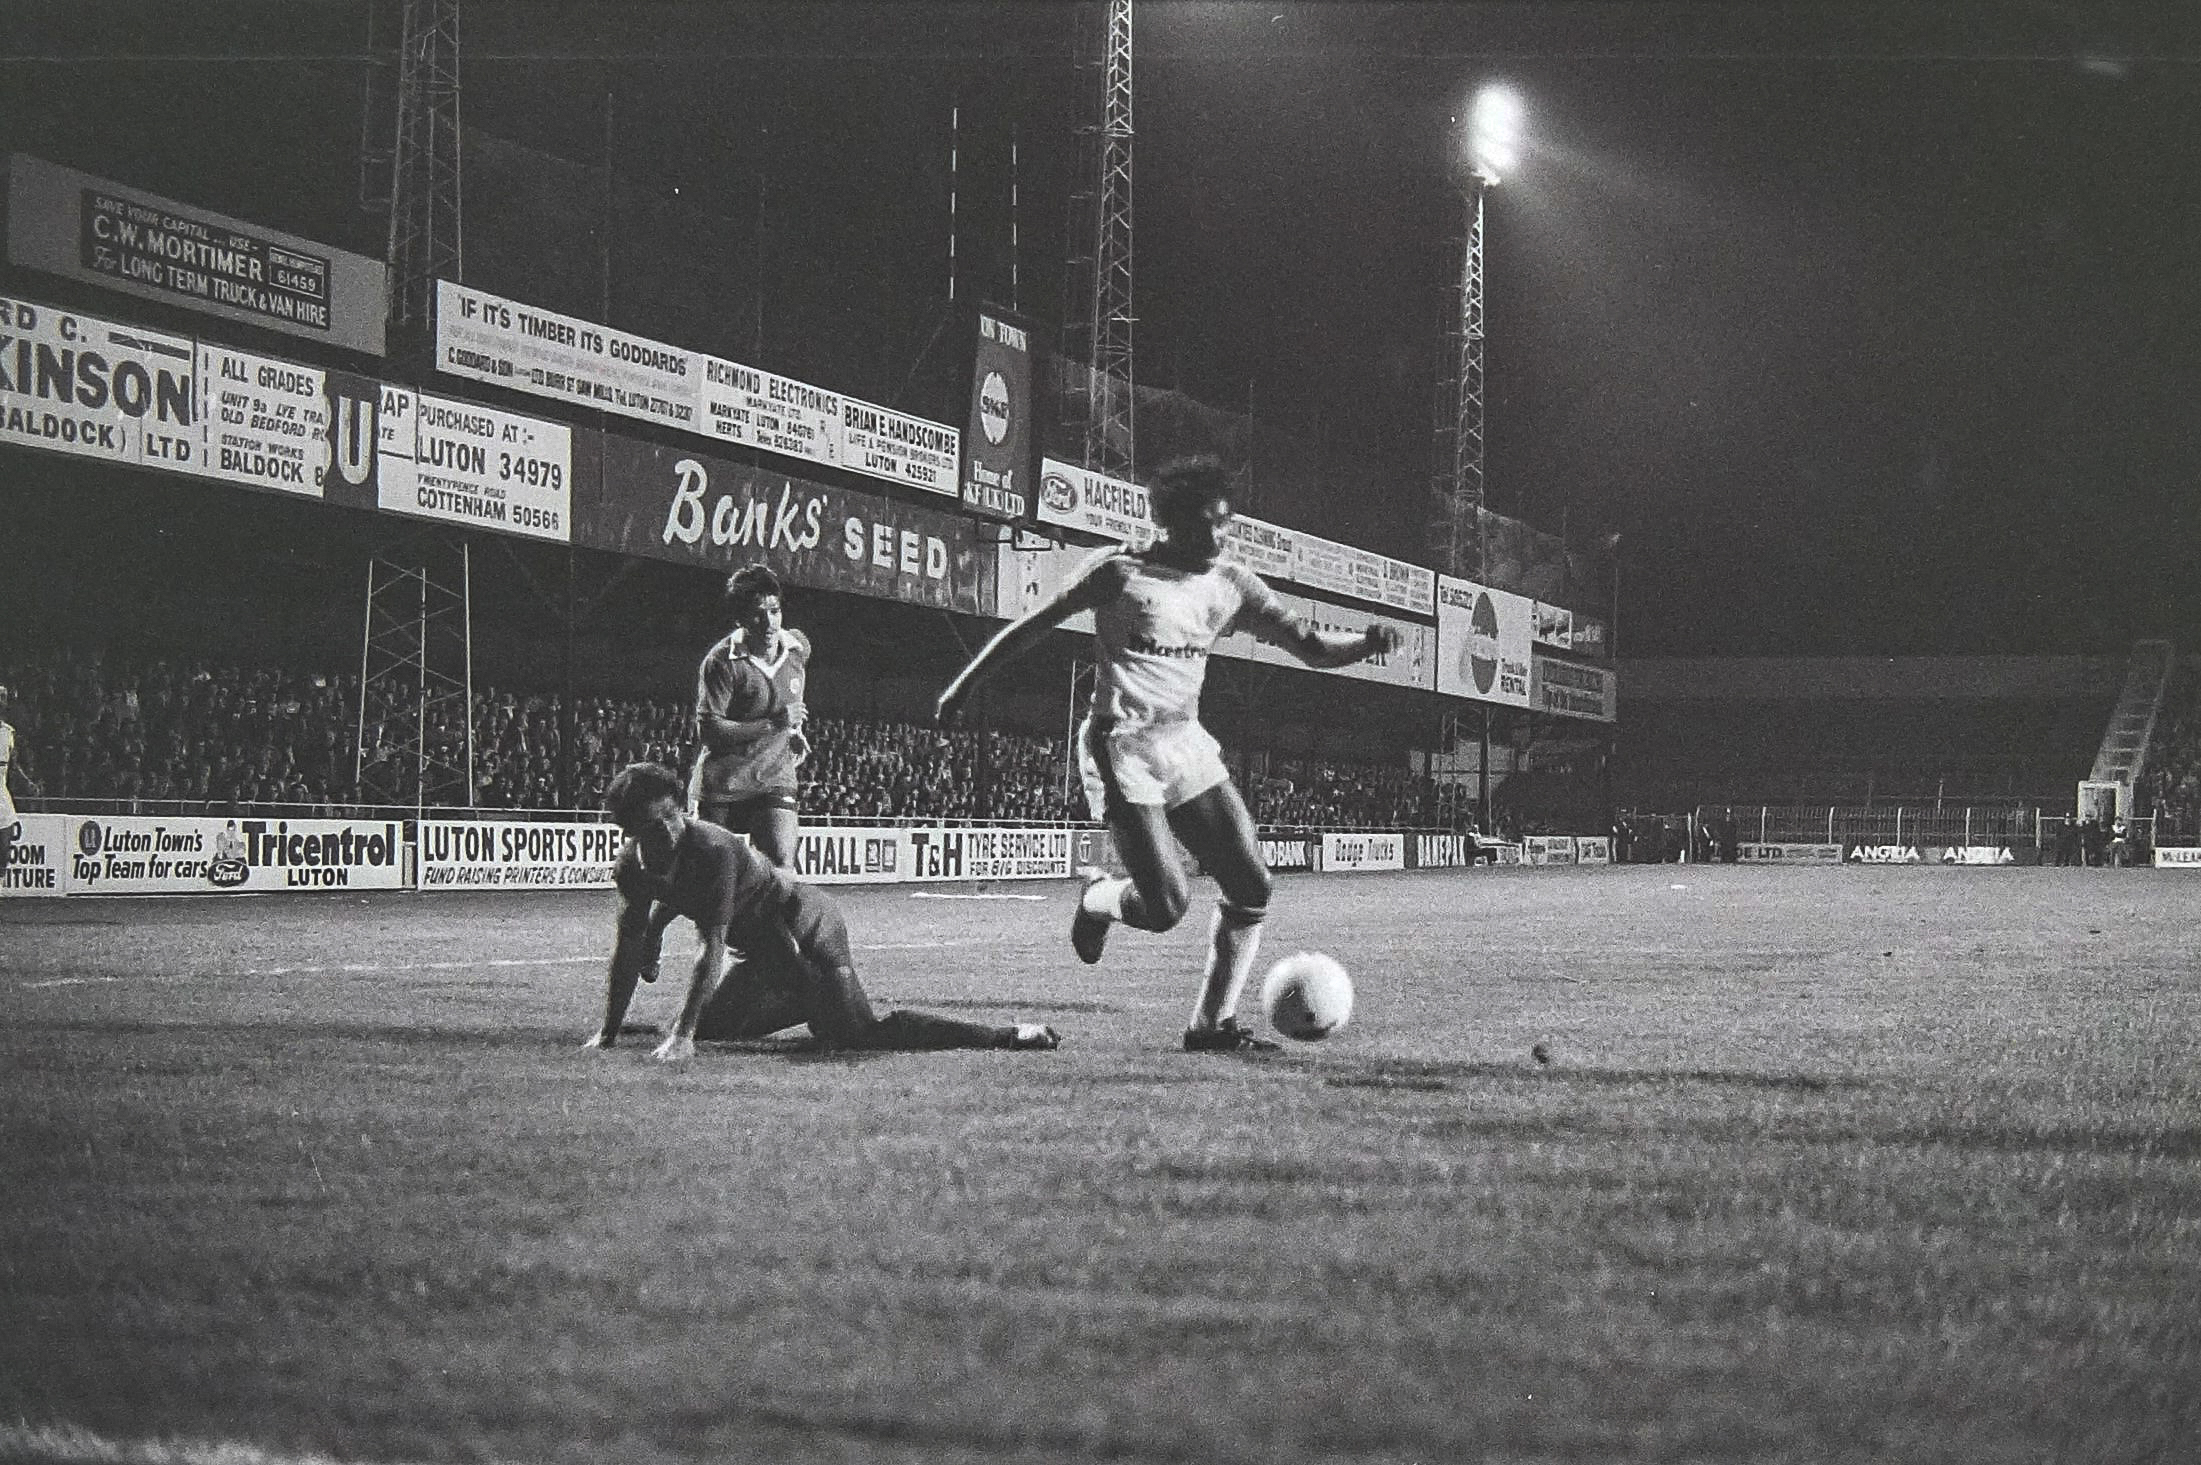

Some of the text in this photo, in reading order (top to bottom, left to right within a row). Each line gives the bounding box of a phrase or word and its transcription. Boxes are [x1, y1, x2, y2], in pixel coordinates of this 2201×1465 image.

[162, 216, 209, 241] CAPITAL
[147, 228, 262, 282] MORTIMER
[121, 253, 163, 284] LONG
[166, 264, 208, 296] TERM
[211, 276, 257, 309] TRUCK
[268, 292, 294, 318] VAN
[296, 300, 328, 327] HIRE
[518, 313, 576, 348] TIMBER
[221, 356, 314, 397] ALL GRADES
[706, 360, 760, 394] RICHMOND
[769, 377, 838, 416] ELECTRONICS
[221, 390, 250, 409] UNIT
[276, 403, 297, 420] LYE
[221, 407, 244, 425] OLD
[251, 414, 306, 437] BEDFORD
[710, 401, 750, 424] MARKYATE
[757, 414, 780, 431] LUTON
[0, 404, 190, 462] ALDOCK) LTD
[417, 404, 495, 439] PURCHASED
[501, 424, 519, 444] AT
[716, 420, 742, 438] HERTS
[845, 405, 877, 434] BRIAN
[888, 418, 957, 456] HANDSCOMBE
[220, 447, 304, 484] BALDOCK
[417, 435, 562, 492] LUTON 34979
[865, 452, 897, 473] LUTON
[416, 486, 506, 522] COTTENHAM
[844, 517, 948, 580] SEED
[104, 826, 203, 852] Luton Town's
[242, 821, 396, 867] Tricentrol
[424, 826, 495, 862] LUTON
[502, 828, 577, 862] SPORTS
[968, 834, 1066, 859] TYRE SERVICE LTD
[73, 854, 208, 885] Top Team for cars
[288, 868, 348, 886] LUTON
[424, 866, 455, 885] FUND
[456, 867, 501, 885] RAISING
[504, 867, 557, 885] PRINTERS
[1016, 861, 1066, 876] DISCOUNTS
